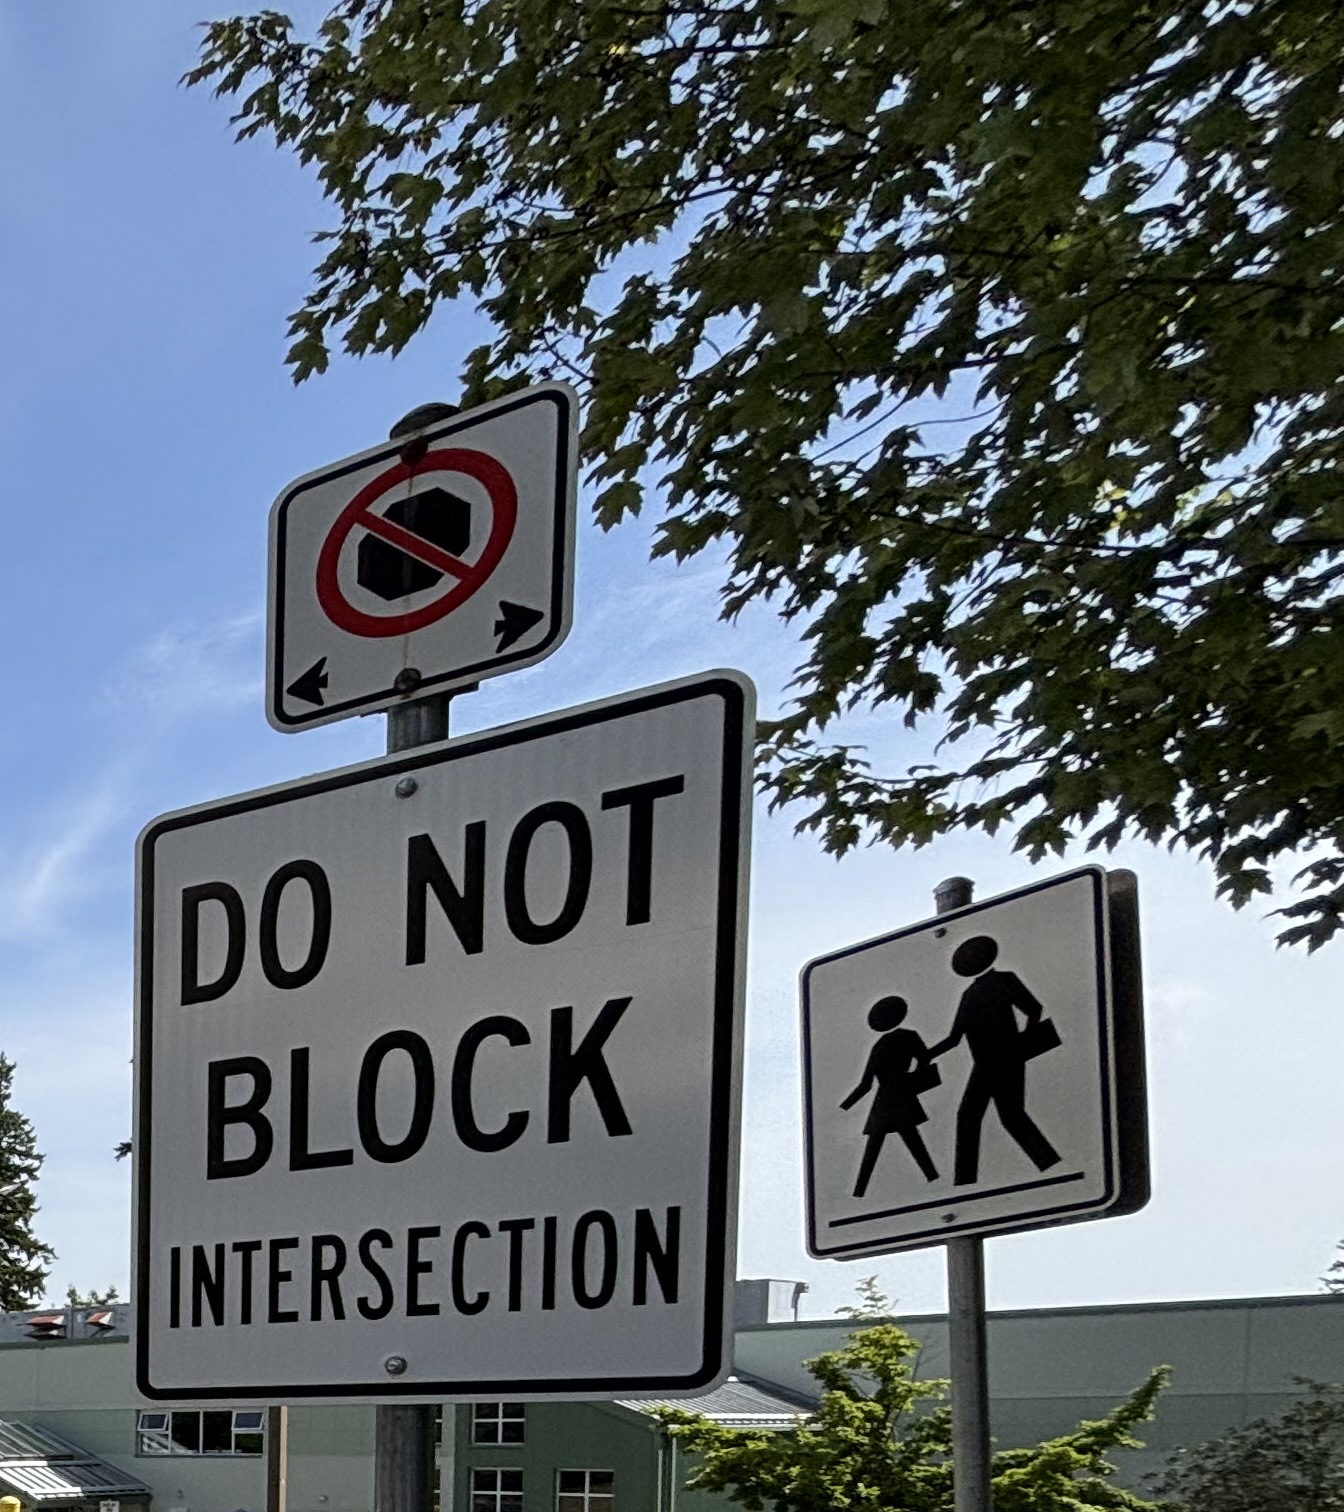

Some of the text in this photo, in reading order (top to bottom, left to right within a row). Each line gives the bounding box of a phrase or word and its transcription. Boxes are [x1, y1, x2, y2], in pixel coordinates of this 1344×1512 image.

[180, 773, 685, 1007] DO NOT
[206, 996, 634, 1181] BLOCK
[169, 1205, 682, 1329] INTERSECTION
